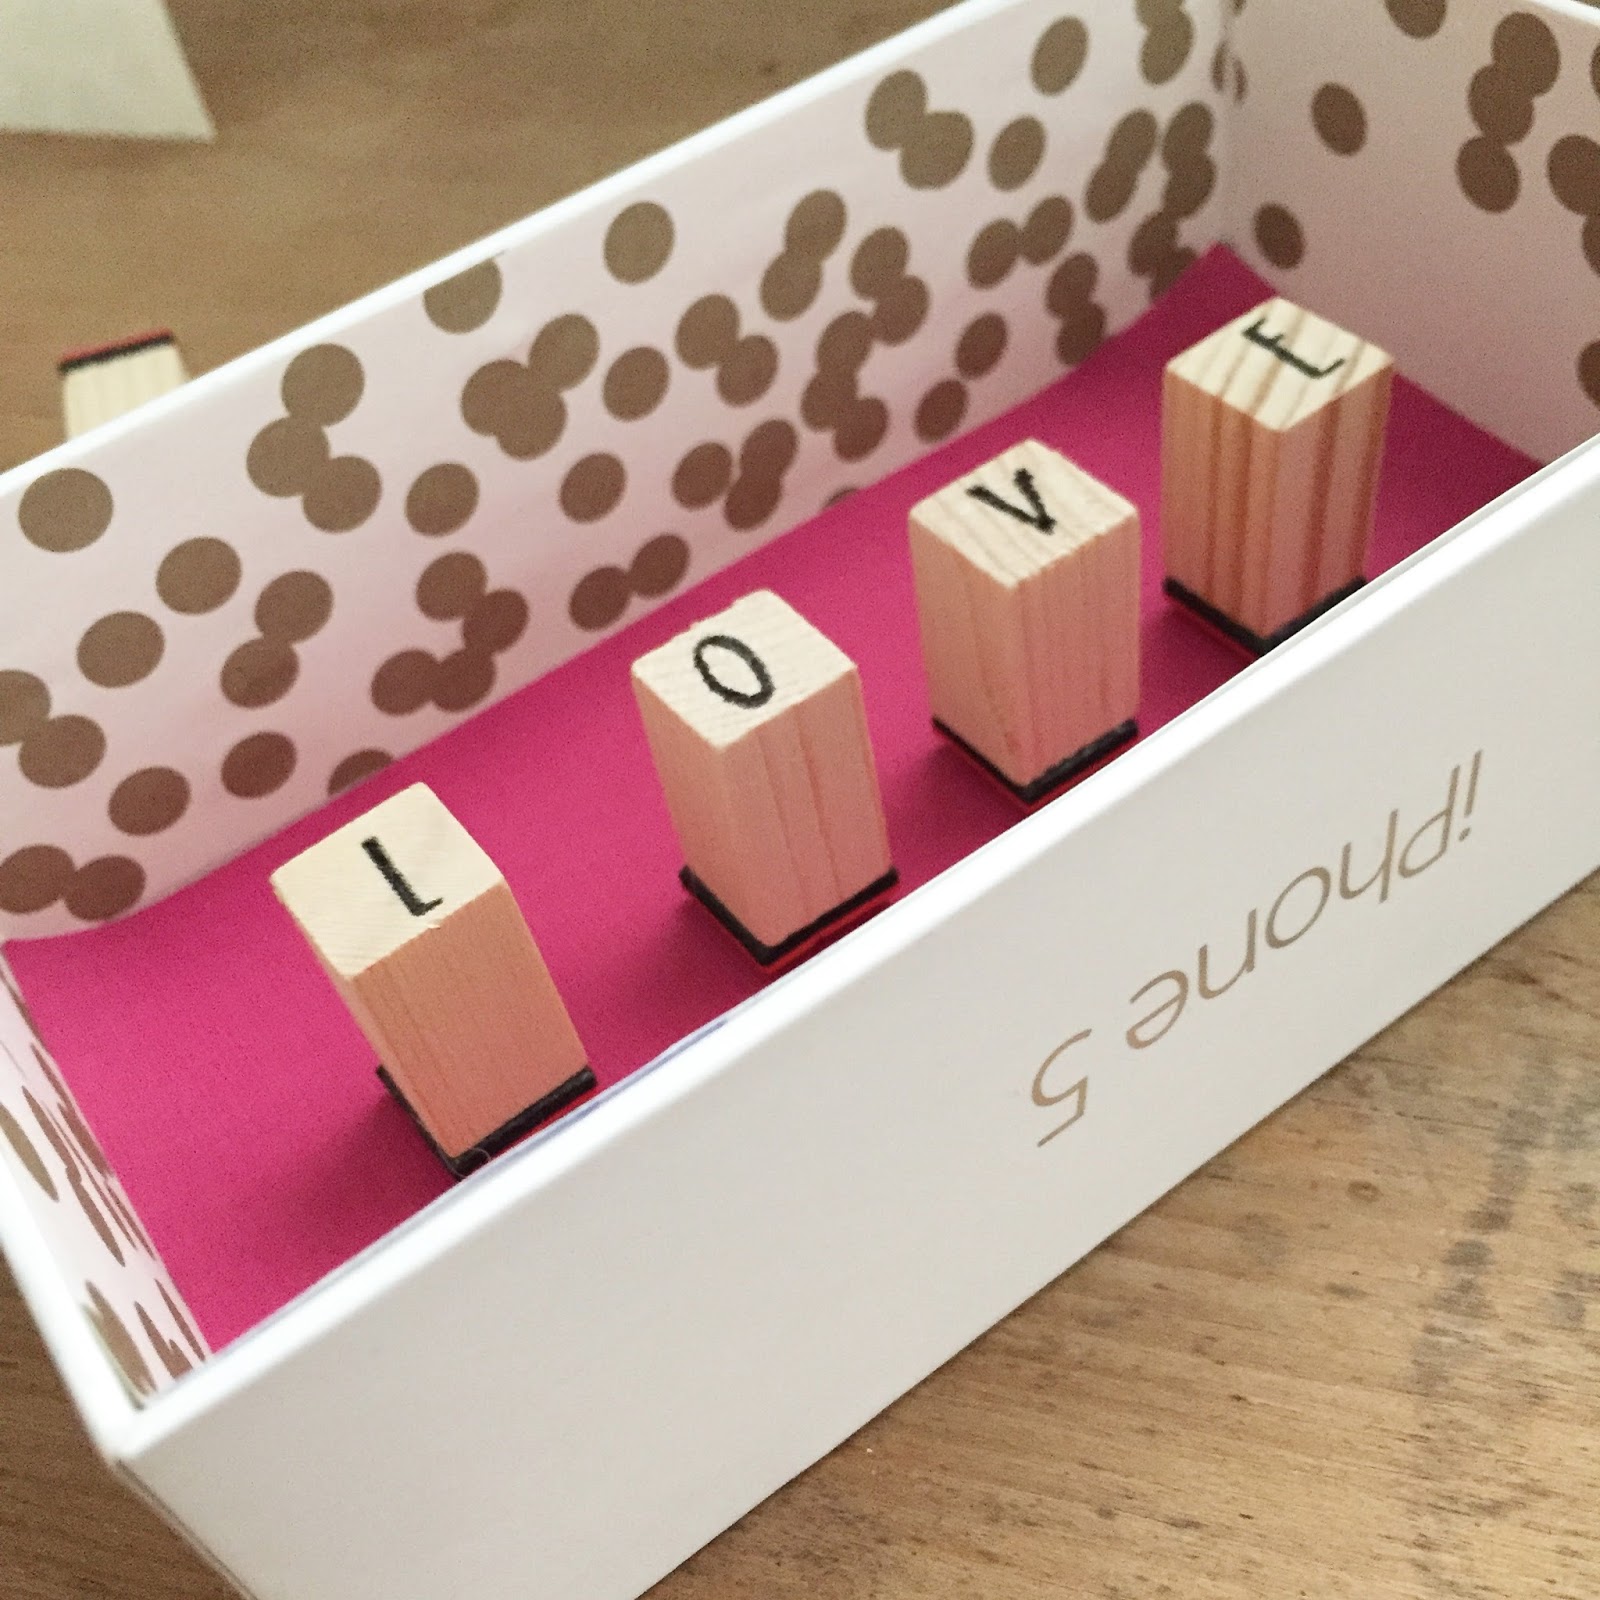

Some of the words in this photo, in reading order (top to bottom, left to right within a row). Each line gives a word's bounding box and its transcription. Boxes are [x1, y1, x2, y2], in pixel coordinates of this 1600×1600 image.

[1242, 316, 1348, 381] E
[967, 467, 1057, 536] V
[692, 634, 775, 708] O
[361, 837, 443, 917] L
[1126, 750, 1484, 1051] iPhone
[1028, 1028, 1094, 1148] 5
